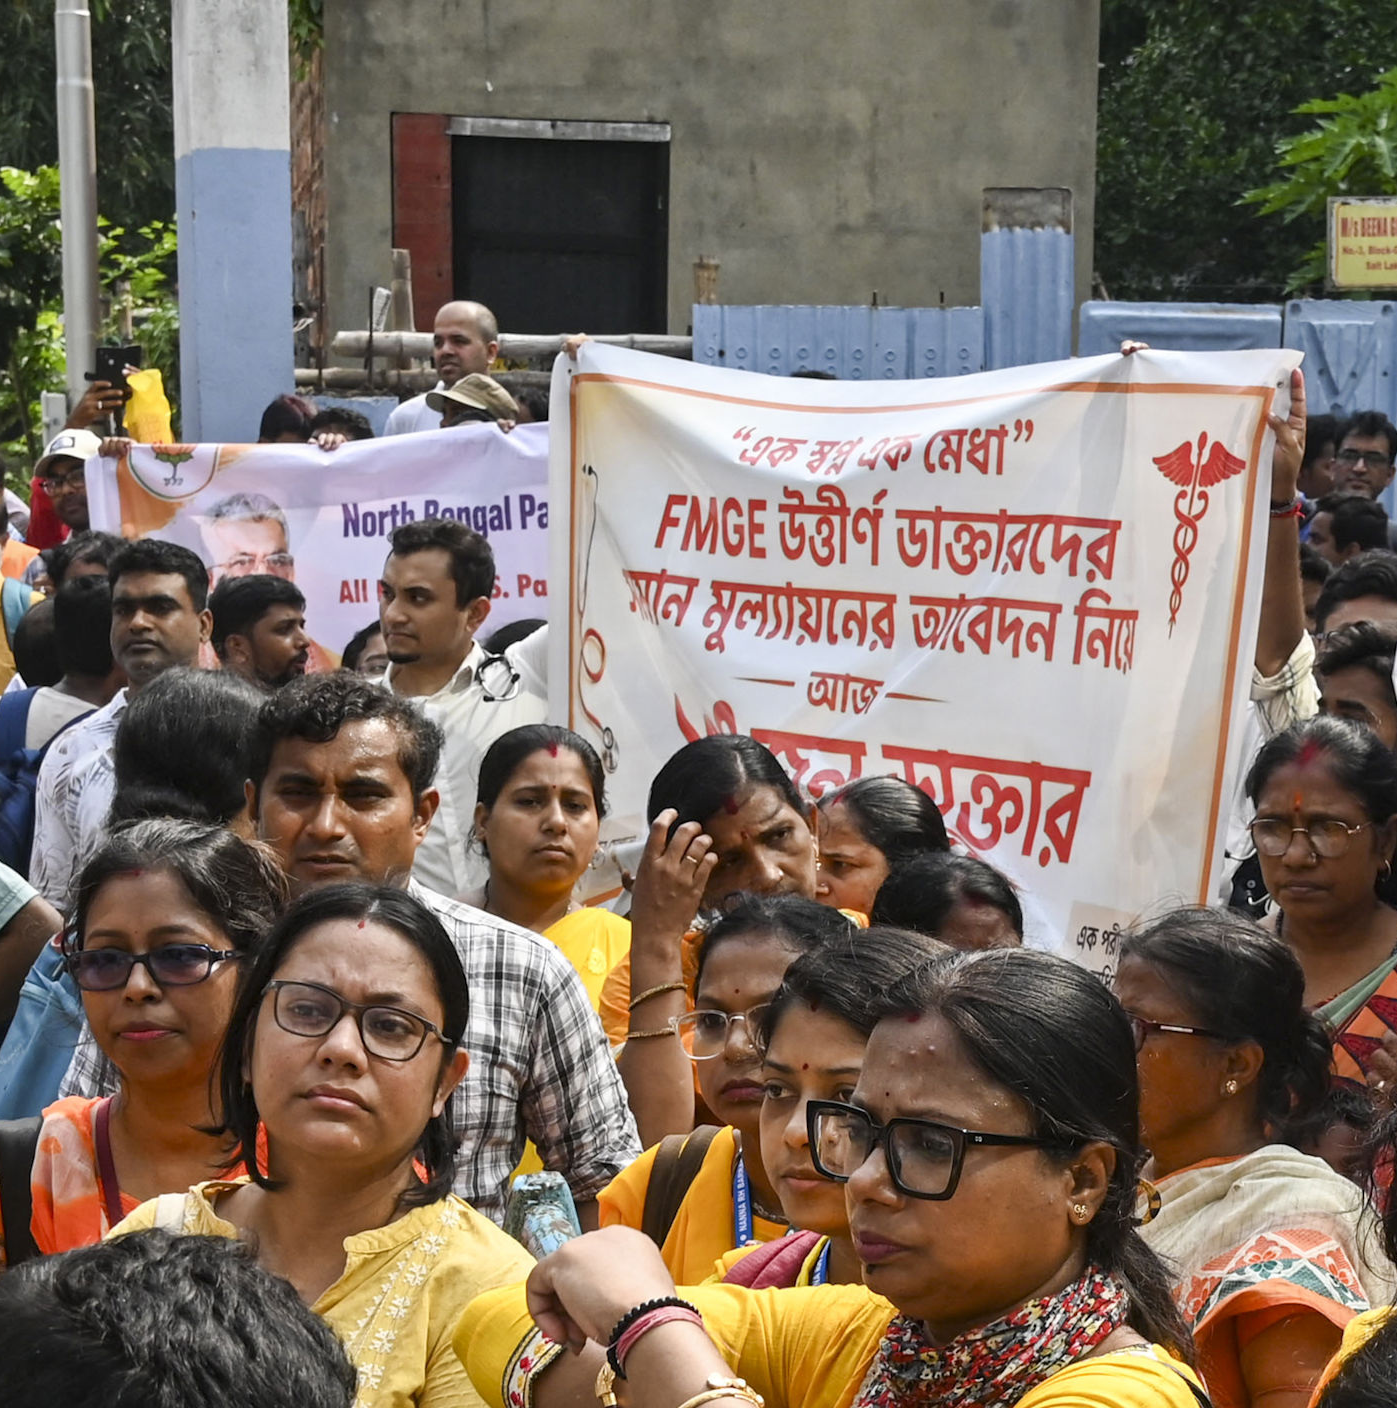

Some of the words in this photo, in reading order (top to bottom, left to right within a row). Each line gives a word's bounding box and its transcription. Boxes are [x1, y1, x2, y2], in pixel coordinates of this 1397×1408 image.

[655, 494, 767, 559] FMGE
[896, 506, 1122, 583] ডাক্তারদের
[807, 671, 885, 715] আজ
[1076, 925, 1100, 951] এক
